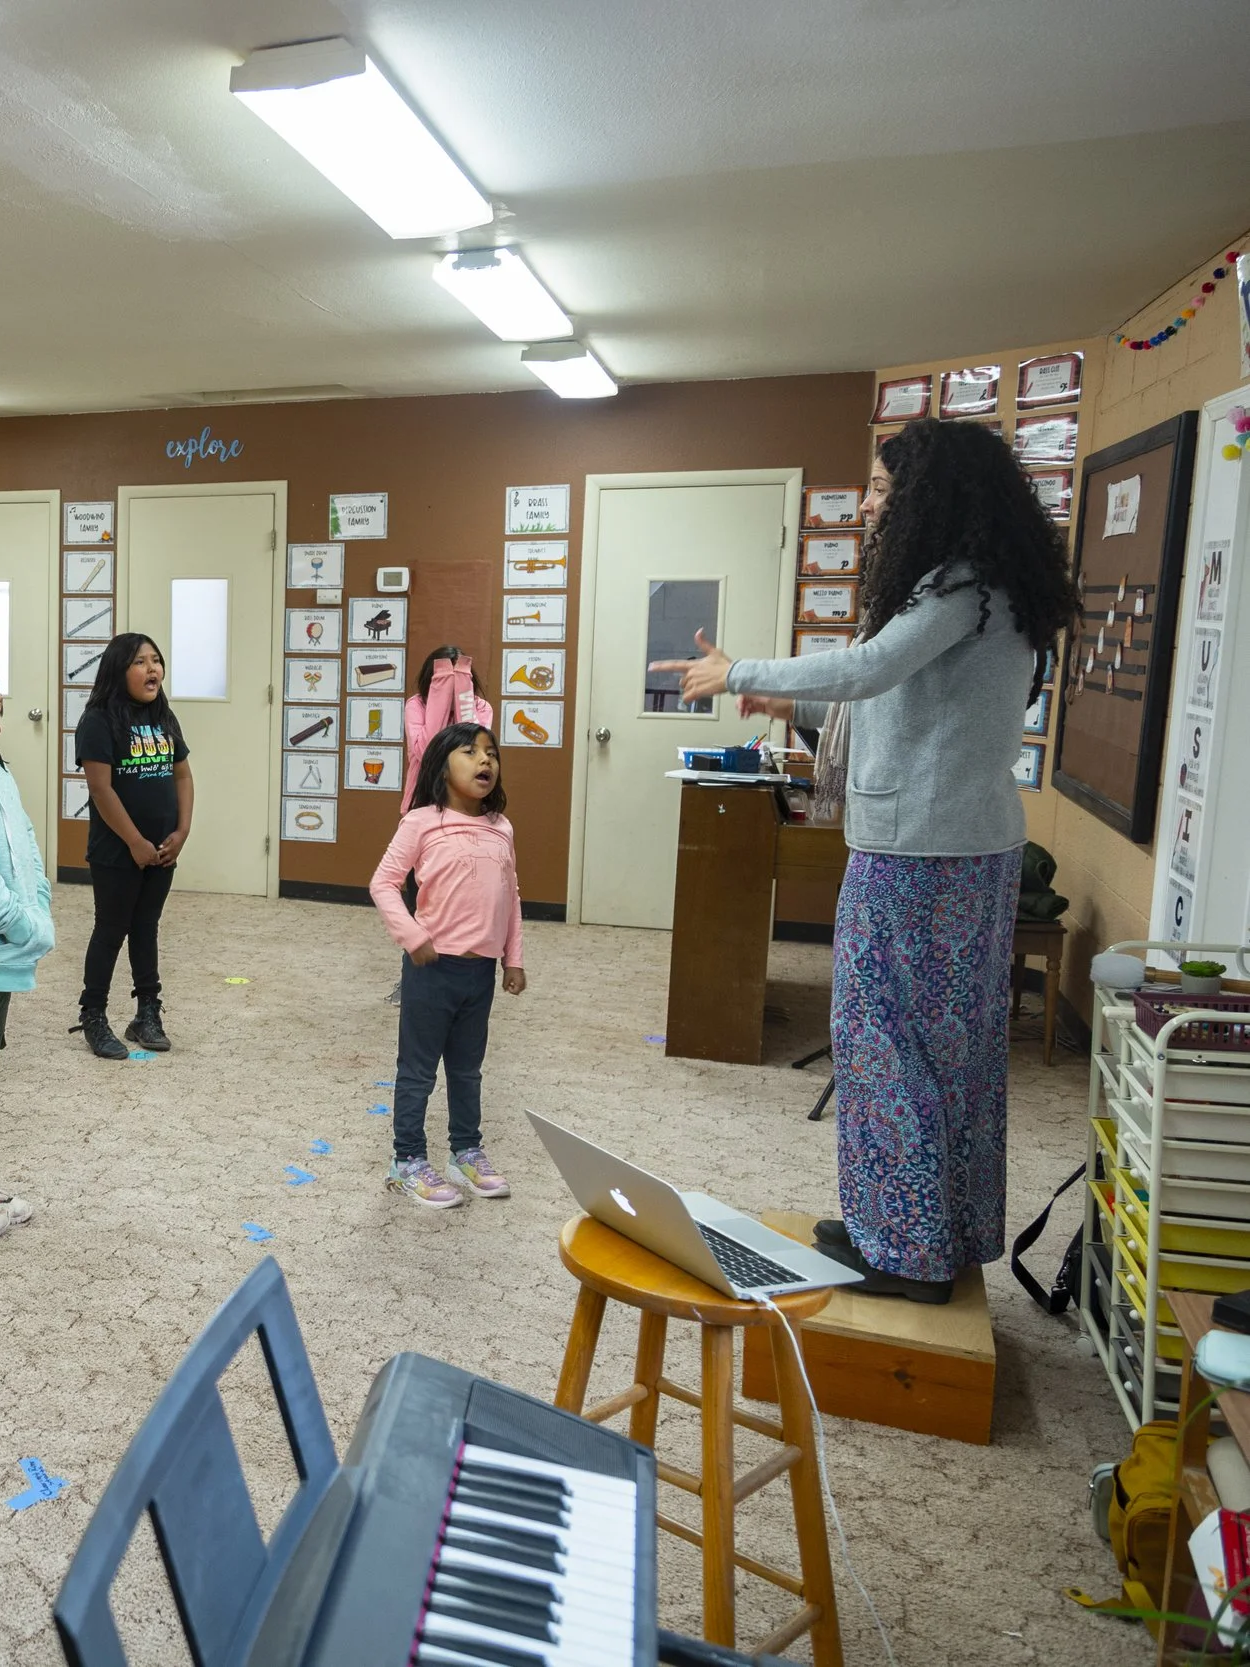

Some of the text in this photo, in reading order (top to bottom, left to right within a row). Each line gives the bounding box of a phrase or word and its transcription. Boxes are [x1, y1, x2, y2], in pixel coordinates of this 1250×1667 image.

[166, 426, 244, 468] explore
[528, 498, 548, 507] BRASS
[341, 505, 376, 514] PERCUSSION
[526, 510, 550, 520] FAMILY
[74, 512, 105, 521] WOODWIND
[347, 518, 370, 526] FAMILY
[1209, 551, 1222, 585] M
[1202, 640, 1211, 672] U
[1192, 726, 1201, 759] S
[121, 755, 169, 766] MOVE
[1174, 895, 1184, 927] C
